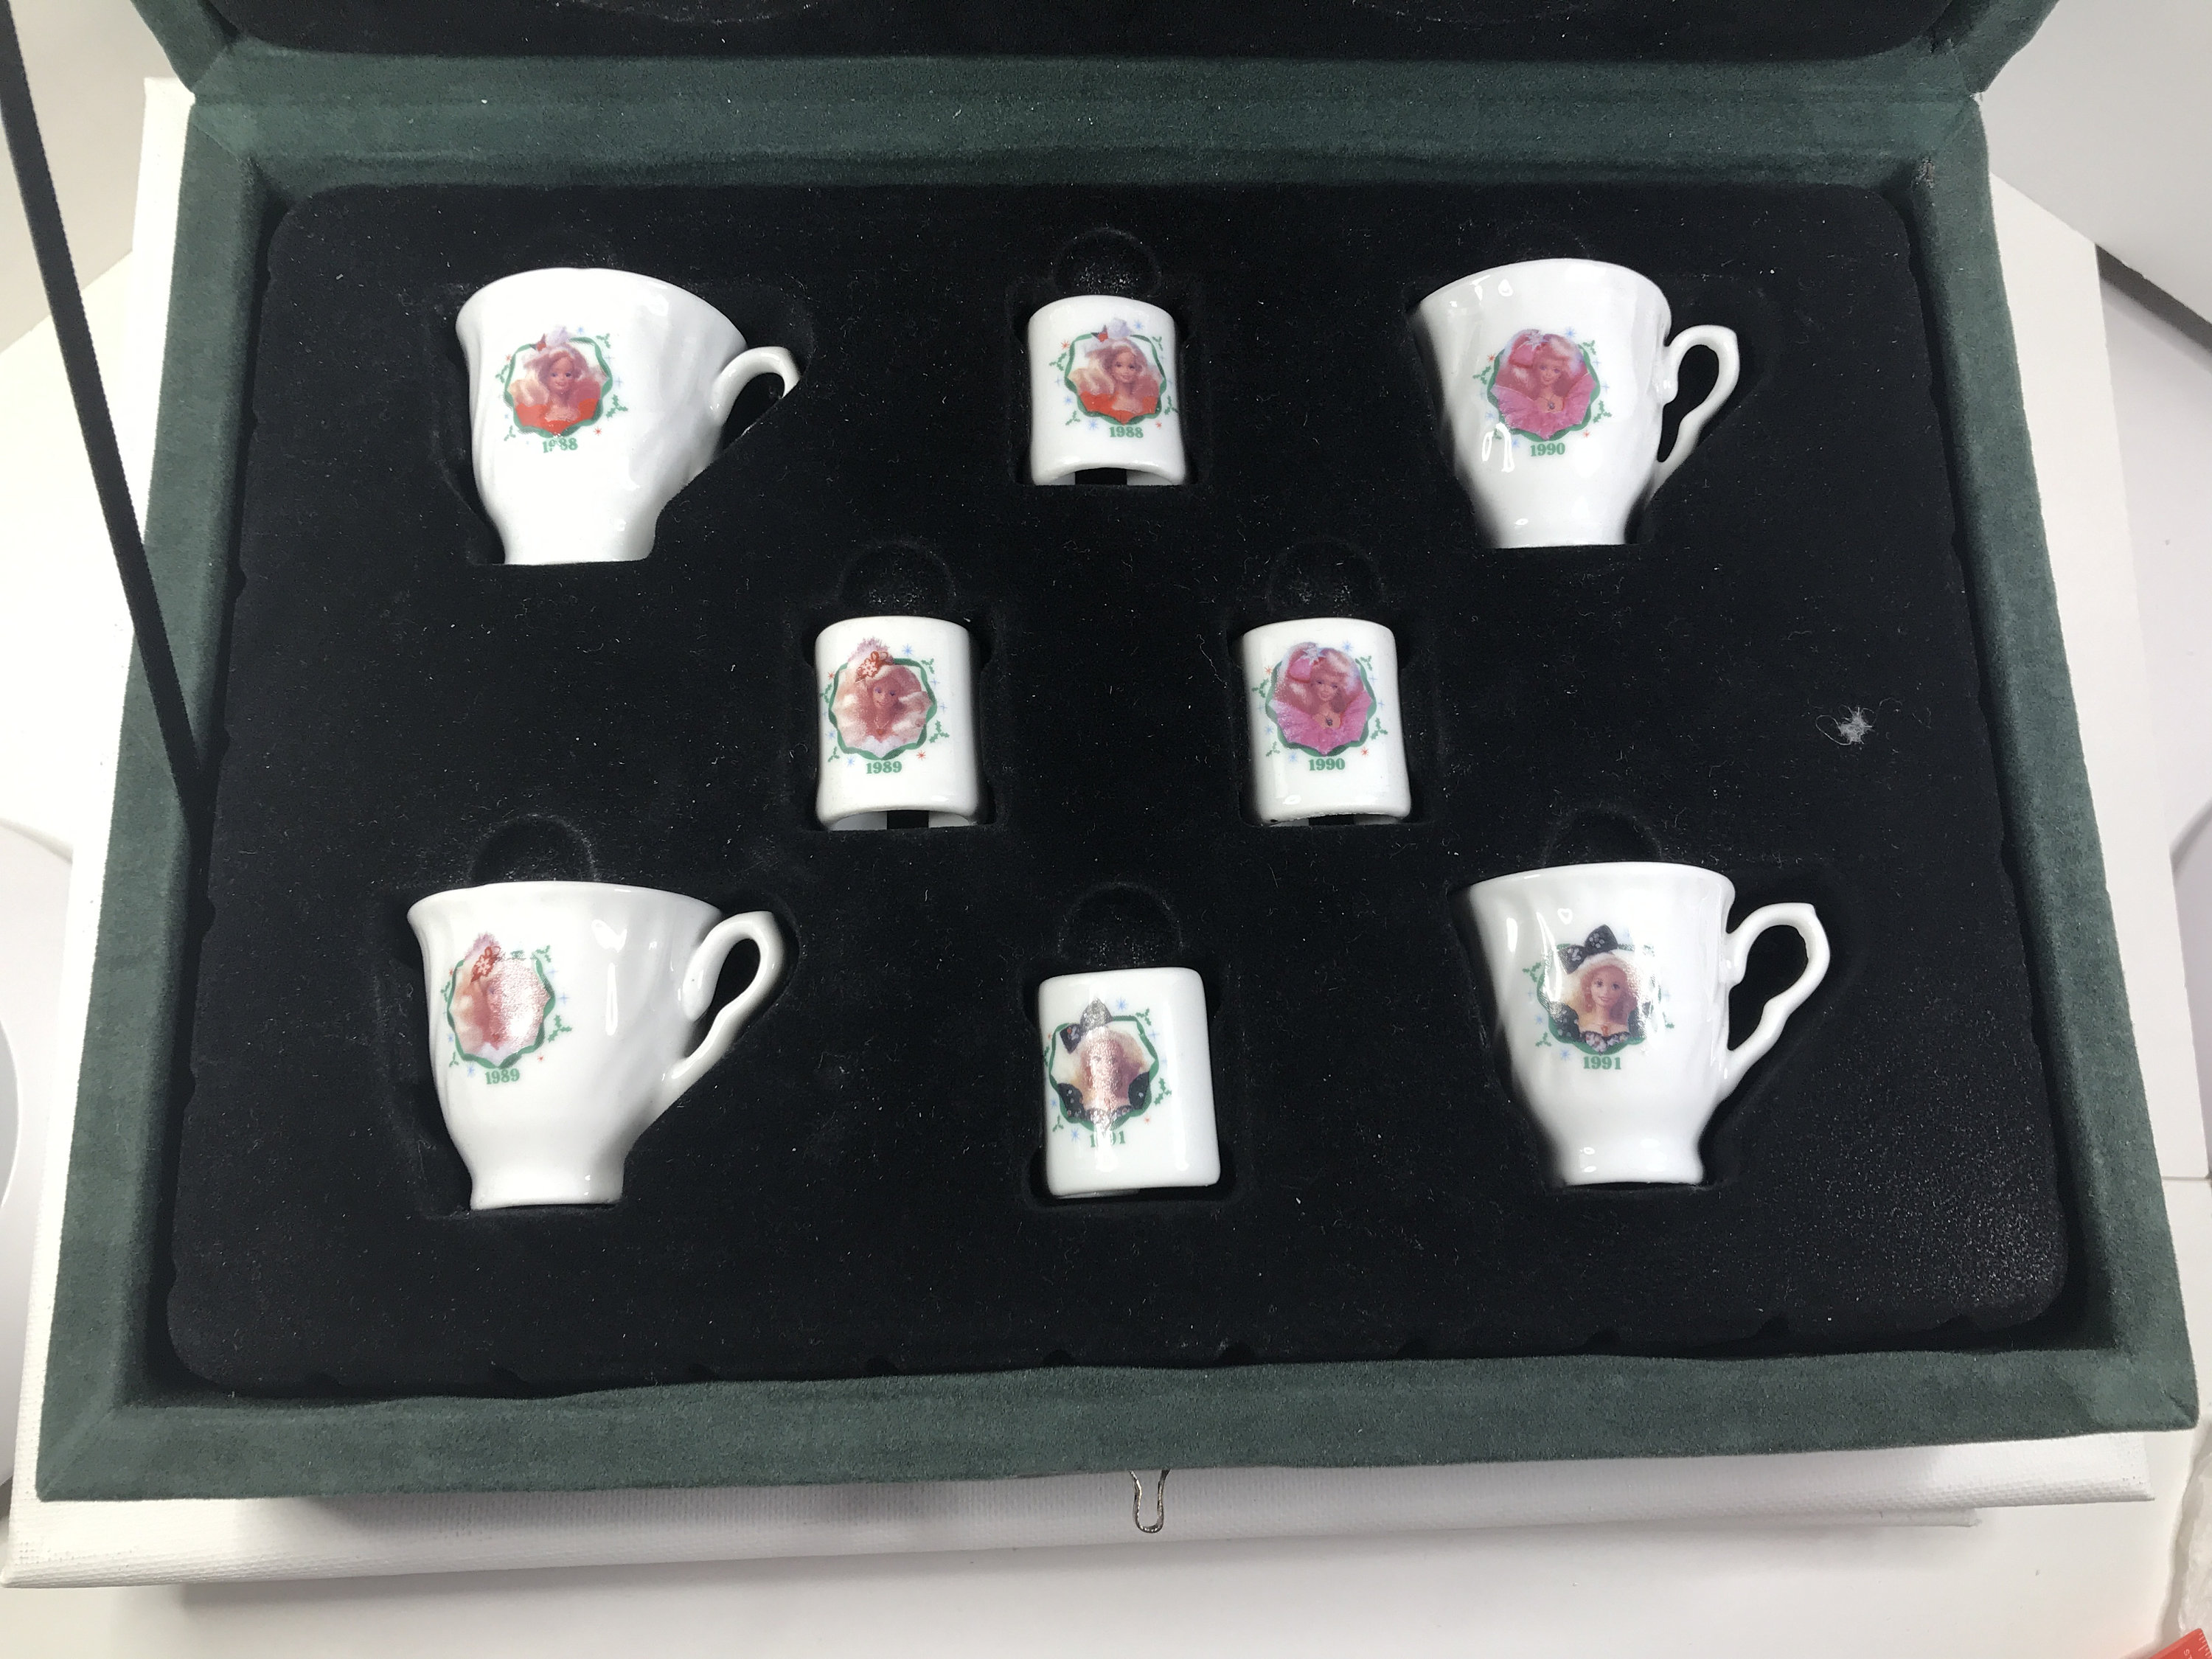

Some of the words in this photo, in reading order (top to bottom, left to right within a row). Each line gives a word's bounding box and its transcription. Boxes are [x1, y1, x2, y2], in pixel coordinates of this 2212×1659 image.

[1109, 426, 1144, 438] 1988
[1530, 442, 1565, 456] 1990
[866, 761, 902, 774] 1989
[1309, 758, 1345, 771] 1990
[1583, 1056, 1621, 1069] 1991
[485, 1068, 520, 1085] 1989
[1090, 1130, 1125, 1147] 11
